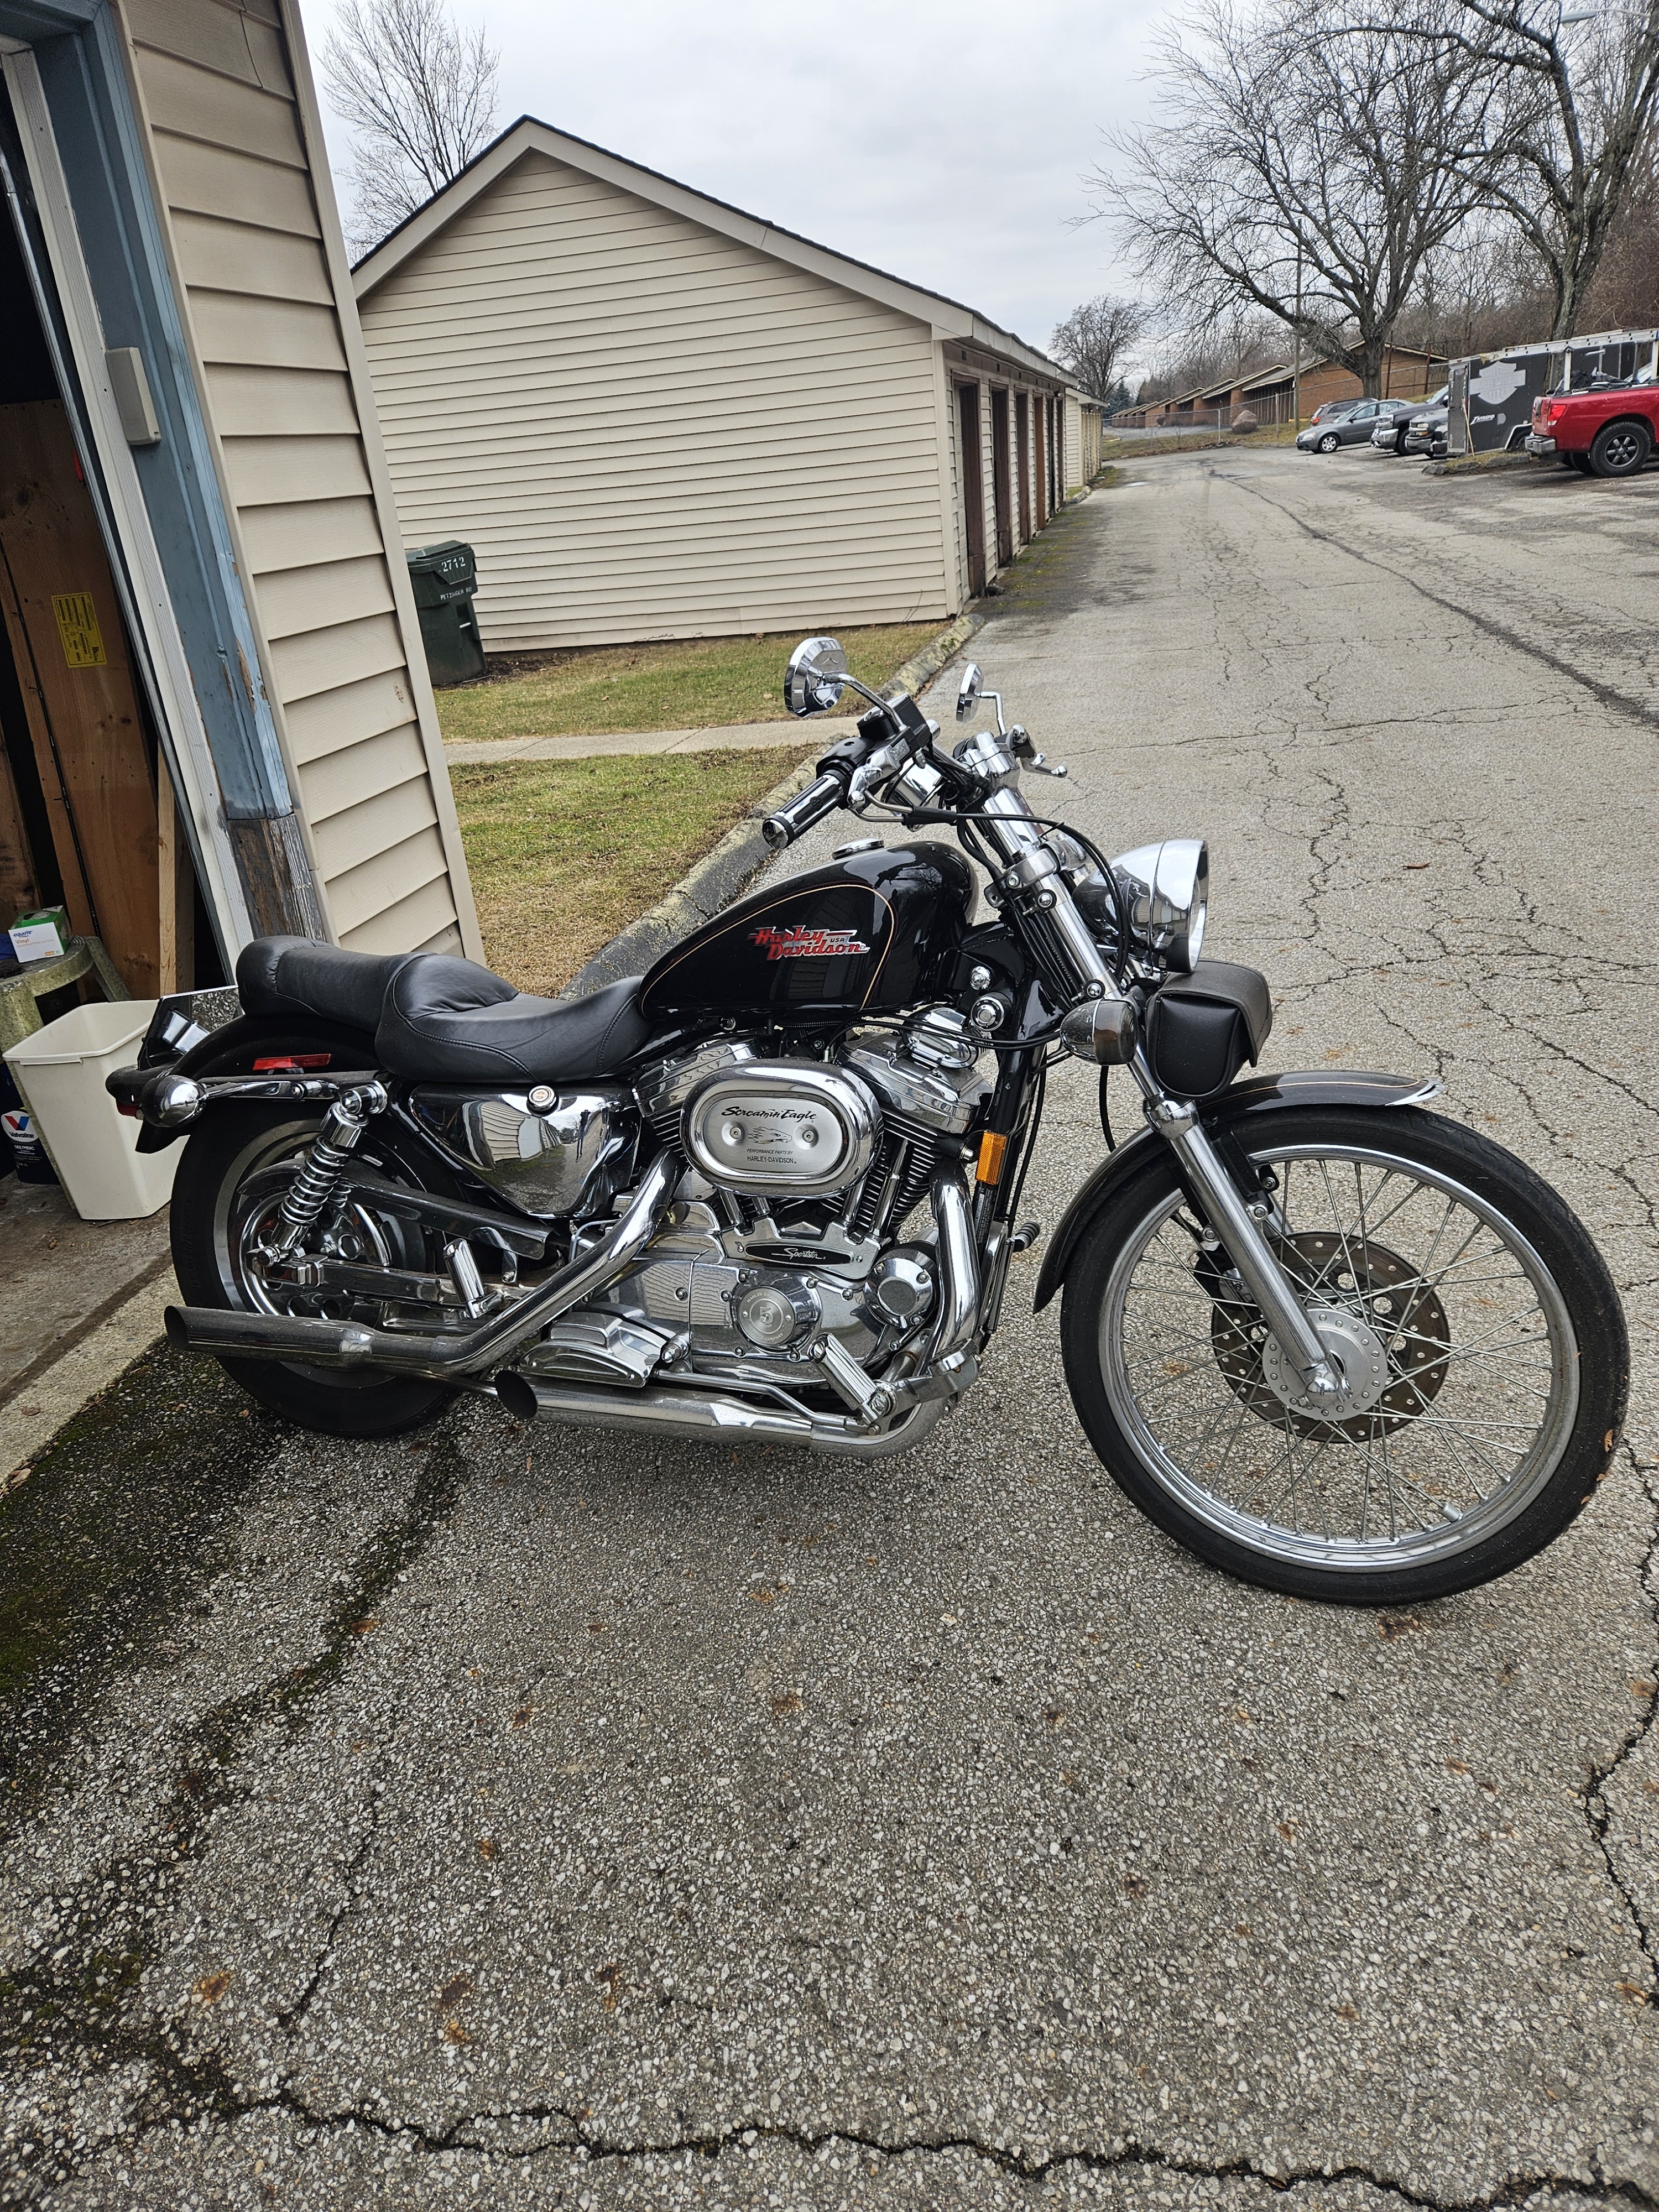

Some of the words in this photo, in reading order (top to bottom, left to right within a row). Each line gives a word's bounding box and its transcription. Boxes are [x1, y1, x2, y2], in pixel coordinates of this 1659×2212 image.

[442, 556, 466, 572] 2712
[750, 926, 830, 946] Harley
[766, 940, 867, 961] Davidson
[780, 1109, 818, 1123] Eagle
[747, 1155, 794, 1164] HARLEY-DAVIDSON
[771, 1248, 823, 1260] Sportster
[759, 1306, 774, 1325] 5
